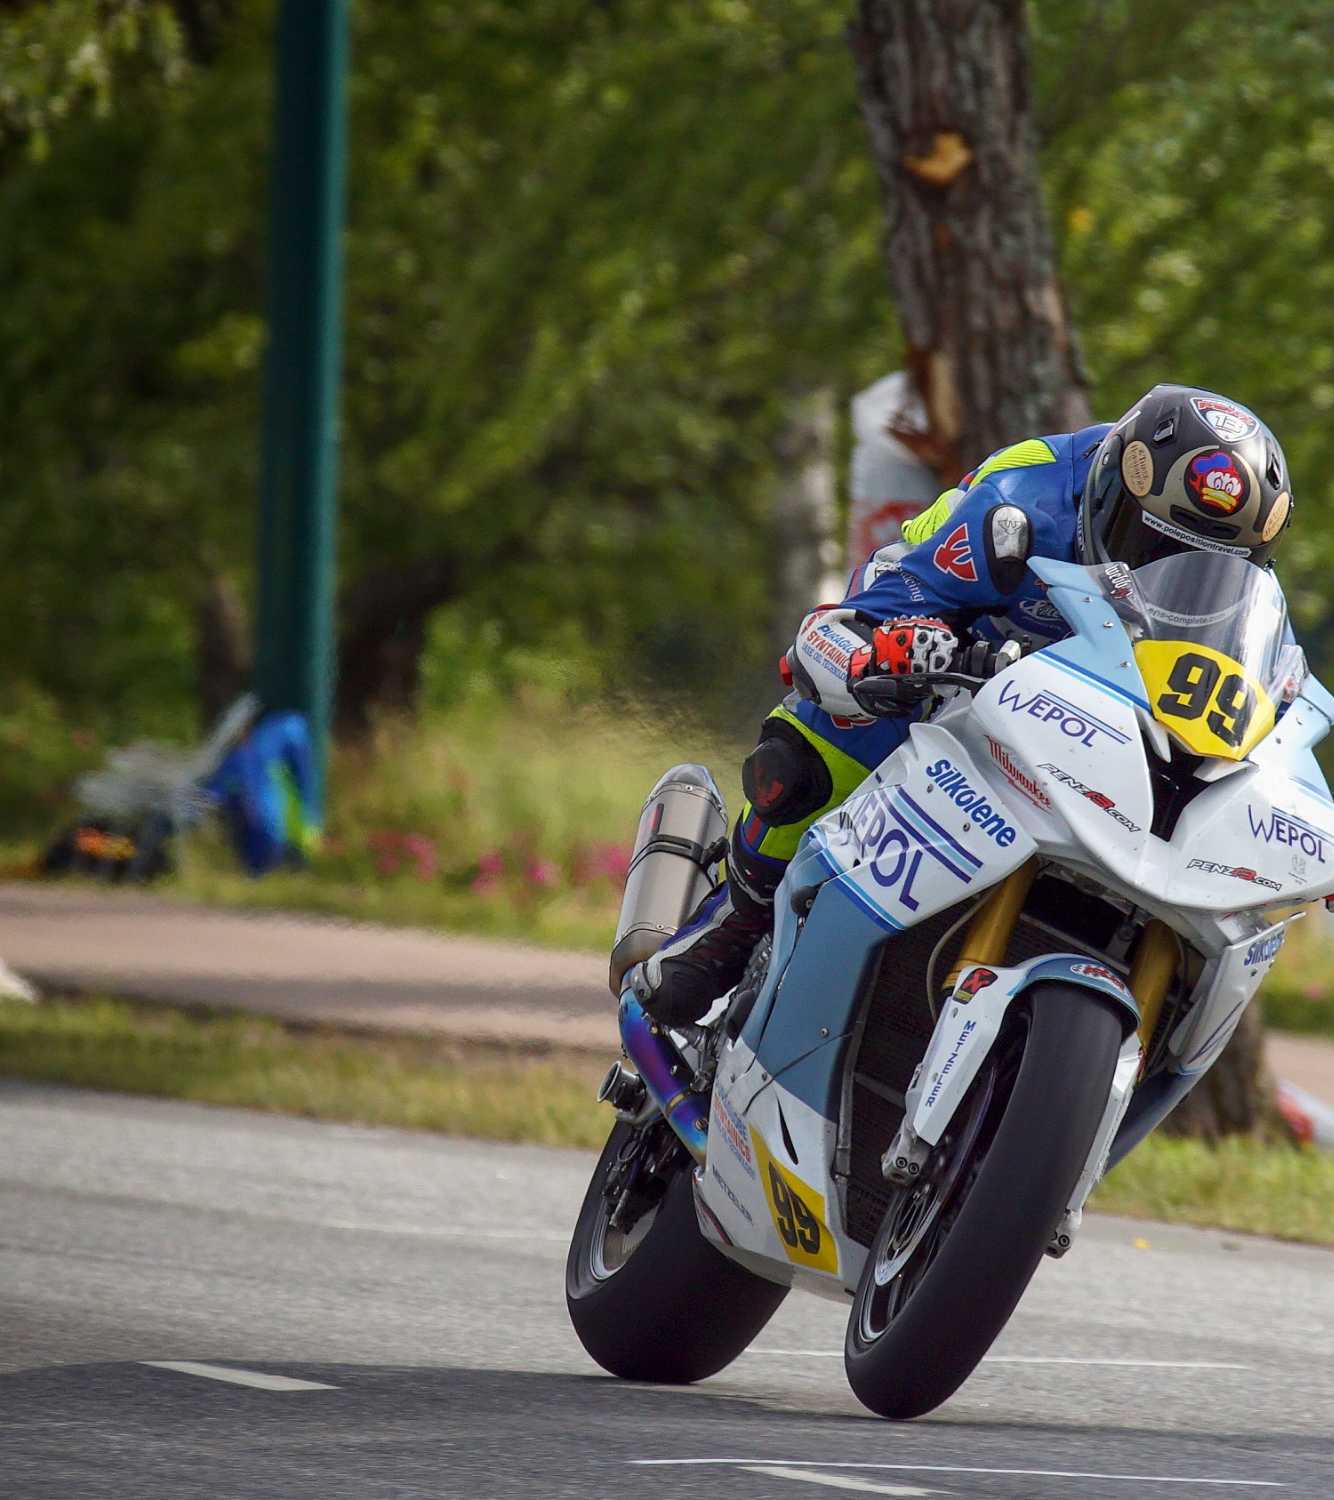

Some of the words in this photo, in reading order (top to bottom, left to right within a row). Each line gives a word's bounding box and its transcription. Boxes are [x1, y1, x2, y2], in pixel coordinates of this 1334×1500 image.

[999, 680, 1099, 747] WEPOL
[1157, 652, 1257, 747] 99
[926, 758, 1017, 848] Silkolene
[1248, 804, 1326, 864] WEPOL
[925, 1020, 976, 1107] METZELER
[768, 1160, 820, 1255] 99
